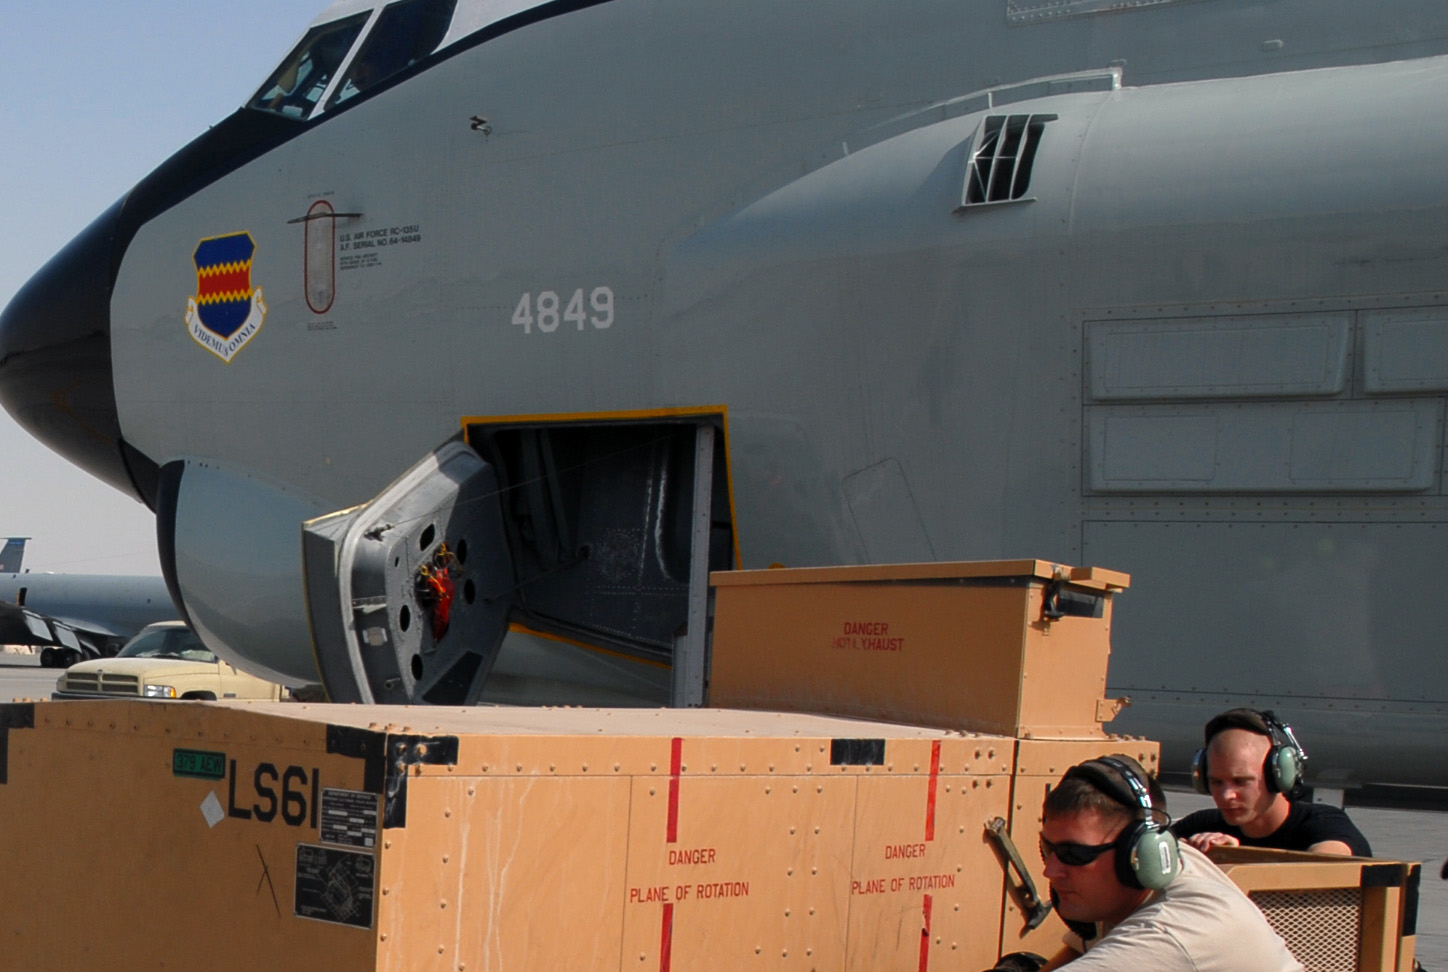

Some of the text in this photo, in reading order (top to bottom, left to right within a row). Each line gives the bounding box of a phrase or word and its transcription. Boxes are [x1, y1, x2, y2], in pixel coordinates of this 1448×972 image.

[340, 234, 351, 242] U.S.
[354, 232, 364, 240] AIR
[366, 228, 388, 238] FORCE
[353, 240, 375, 250] SERIAL
[512, 286, 614, 334] 4849
[194, 323, 256, 357] VIDEMUS OMNIA
[844, 622, 889, 636] DANGER
[176, 753, 223, 775] 379 AEW
[668, 848, 717, 866] DANGER
[885, 843, 927, 860] DANGER
[630, 881, 750, 904] PLANE OF ROTATION
[852, 874, 956, 895] PLANE OF ROTATION
